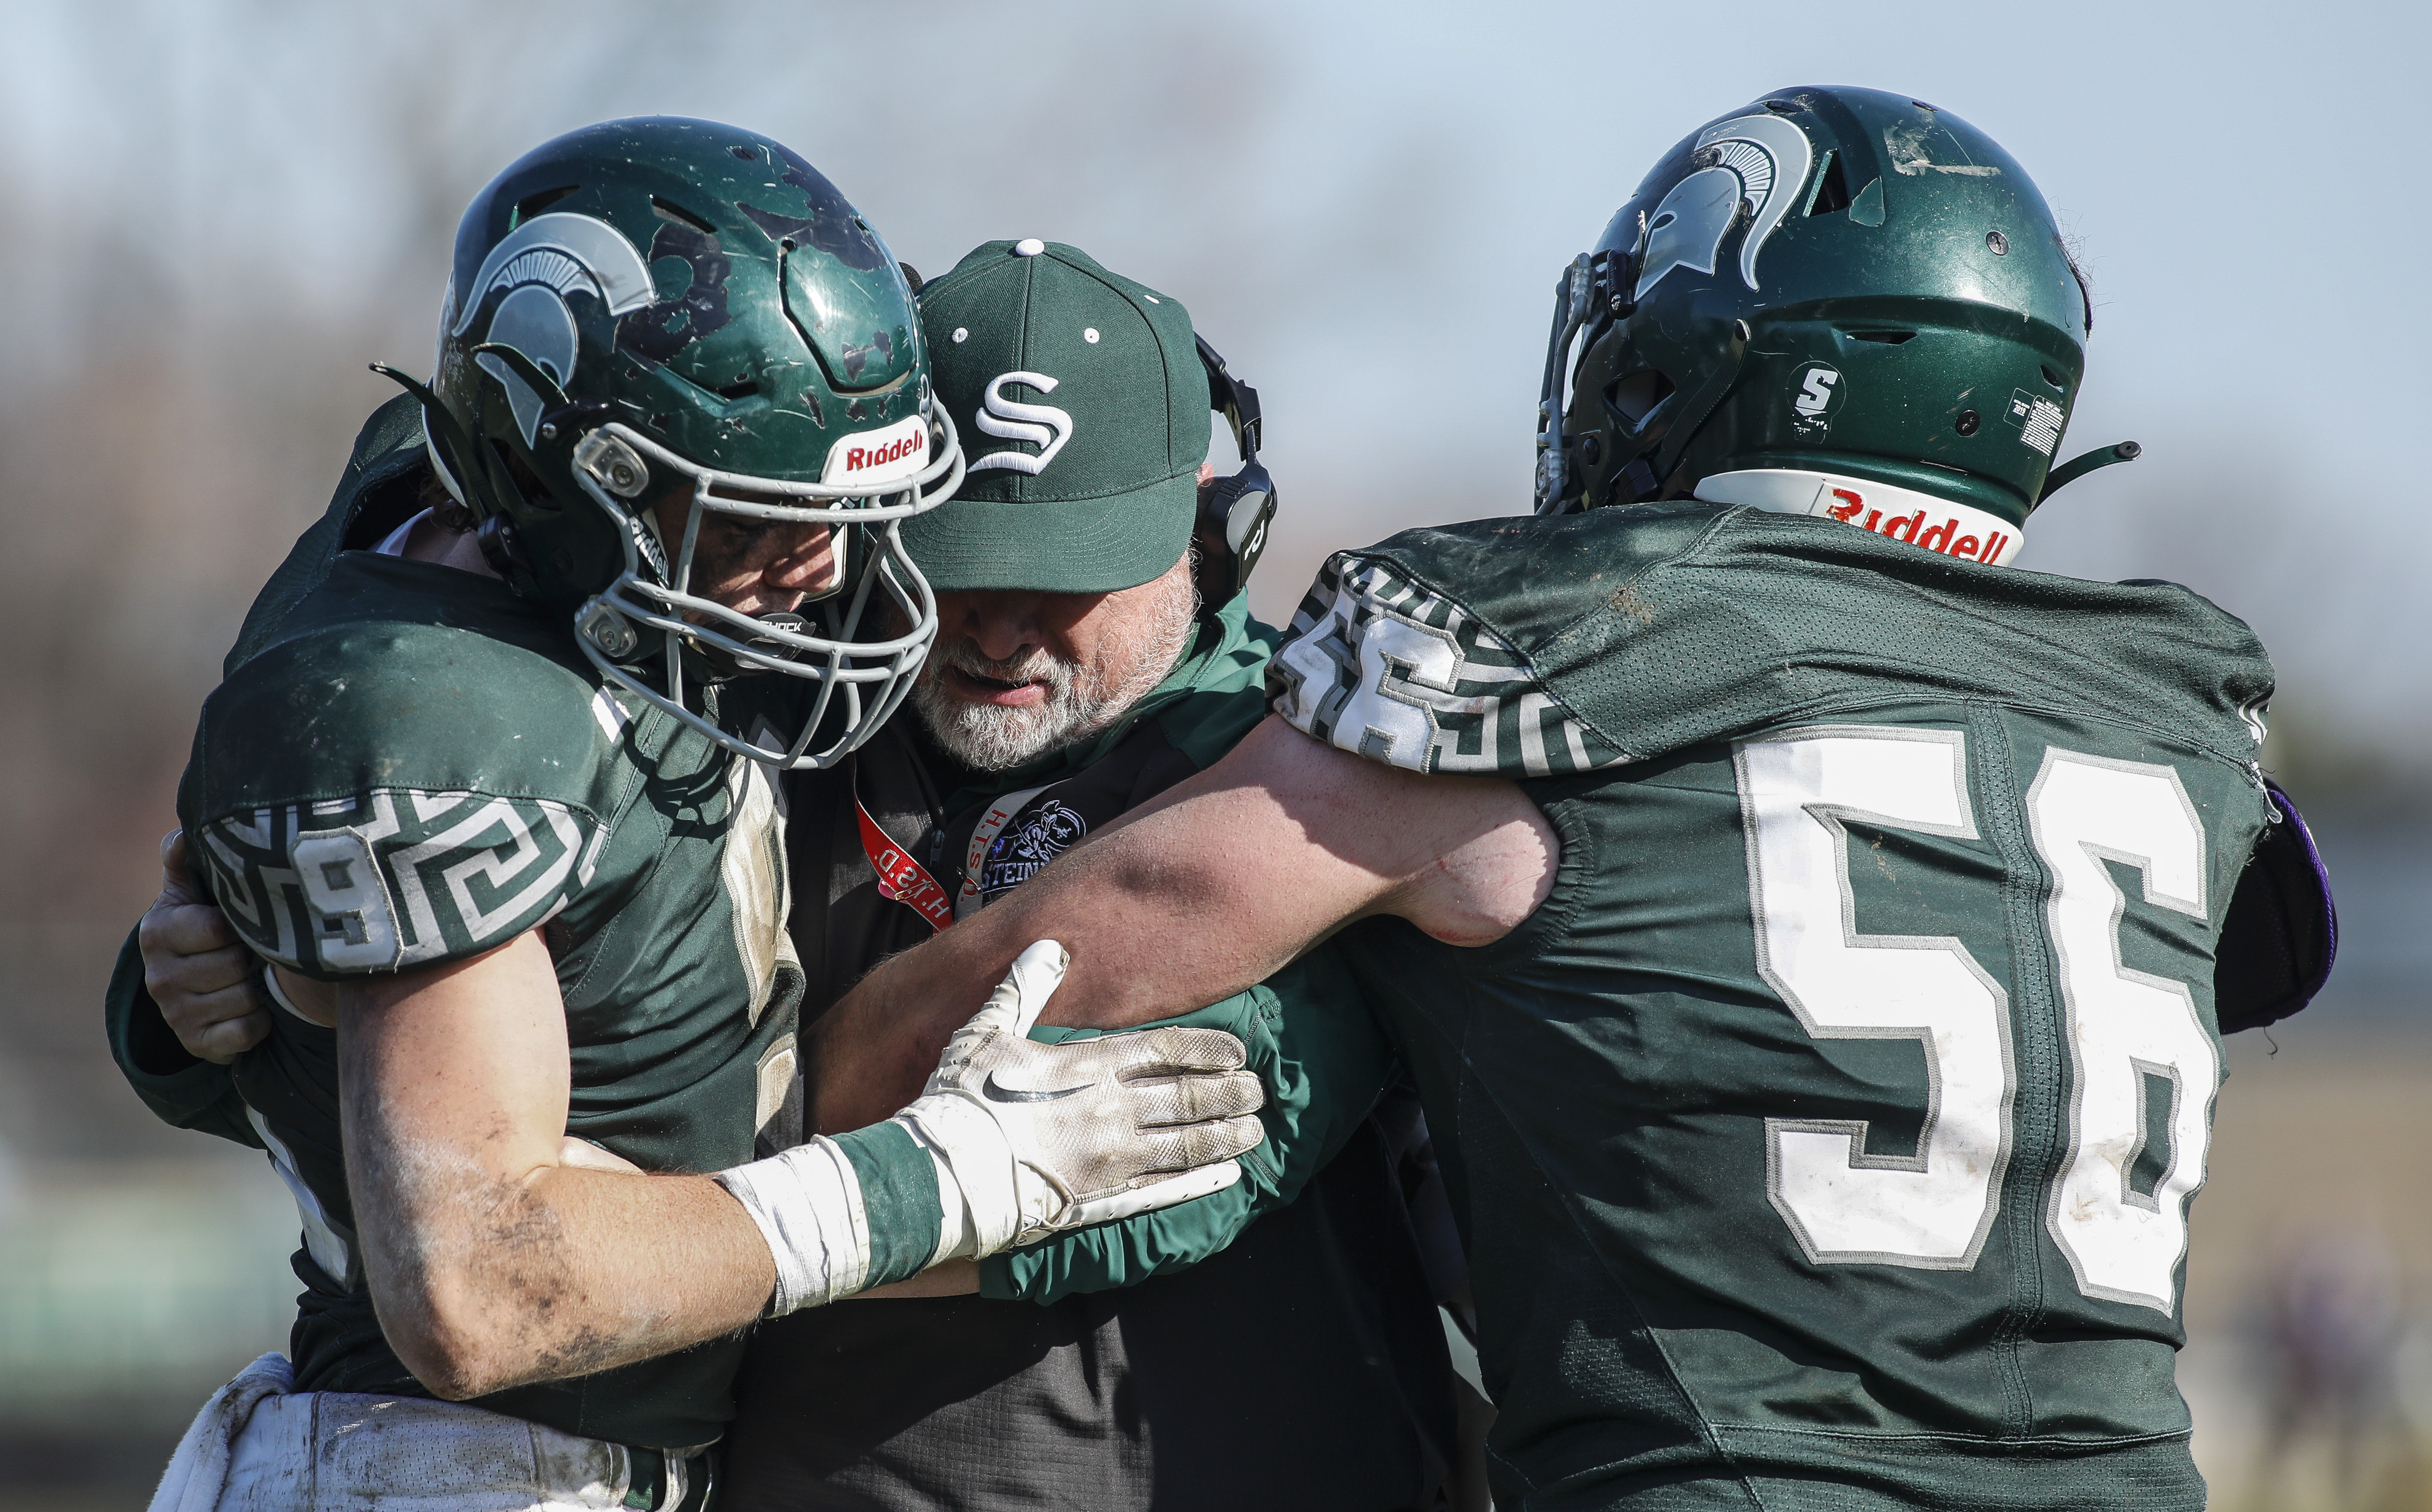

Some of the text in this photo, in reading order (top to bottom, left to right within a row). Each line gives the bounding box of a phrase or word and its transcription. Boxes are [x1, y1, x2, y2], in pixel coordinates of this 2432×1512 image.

[967, 370, 1073, 476] S
[1796, 368, 1838, 410] S
[2014, 404, 2026, 415] 2019
[847, 429, 923, 471] Riddell
[1825, 488, 2008, 565] Riddell
[287, 826, 405, 973] 9
[1731, 724, 2220, 1318] 56
